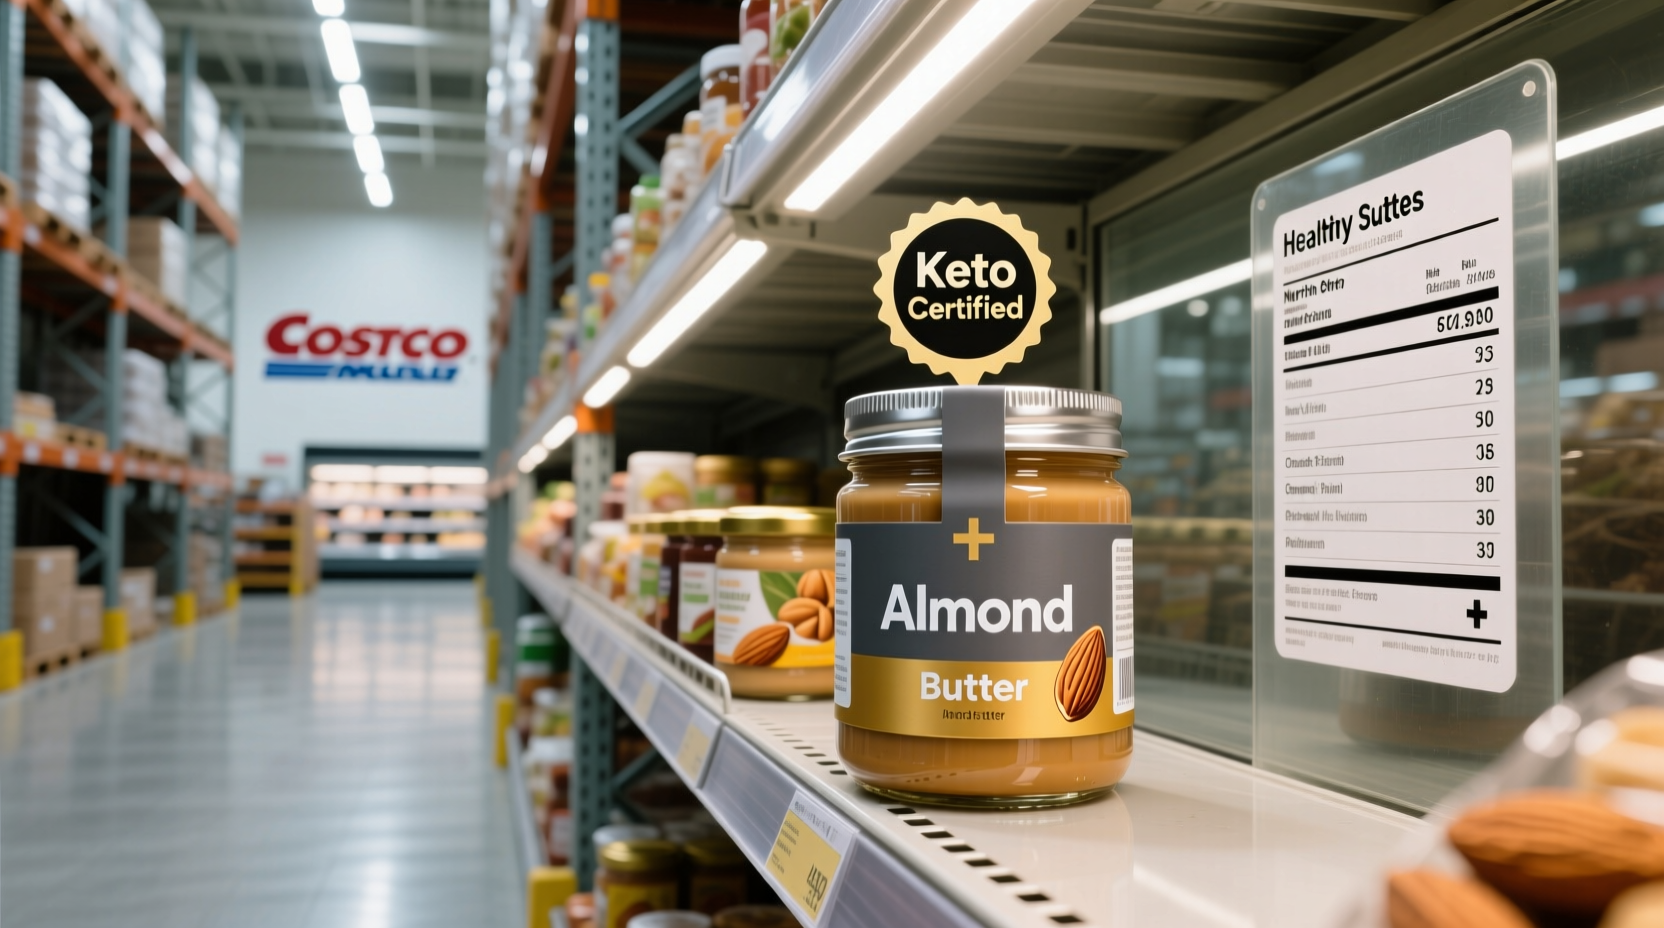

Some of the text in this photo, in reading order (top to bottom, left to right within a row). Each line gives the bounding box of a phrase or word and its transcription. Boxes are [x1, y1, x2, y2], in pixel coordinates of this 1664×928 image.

[916, 251, 1017, 289] Keto
[907, 294, 1024, 321] Certified
[1475, 508, 1494, 526] 30
[880, 583, 1073, 633] Almond
[920, 671, 1028, 702] Butter
